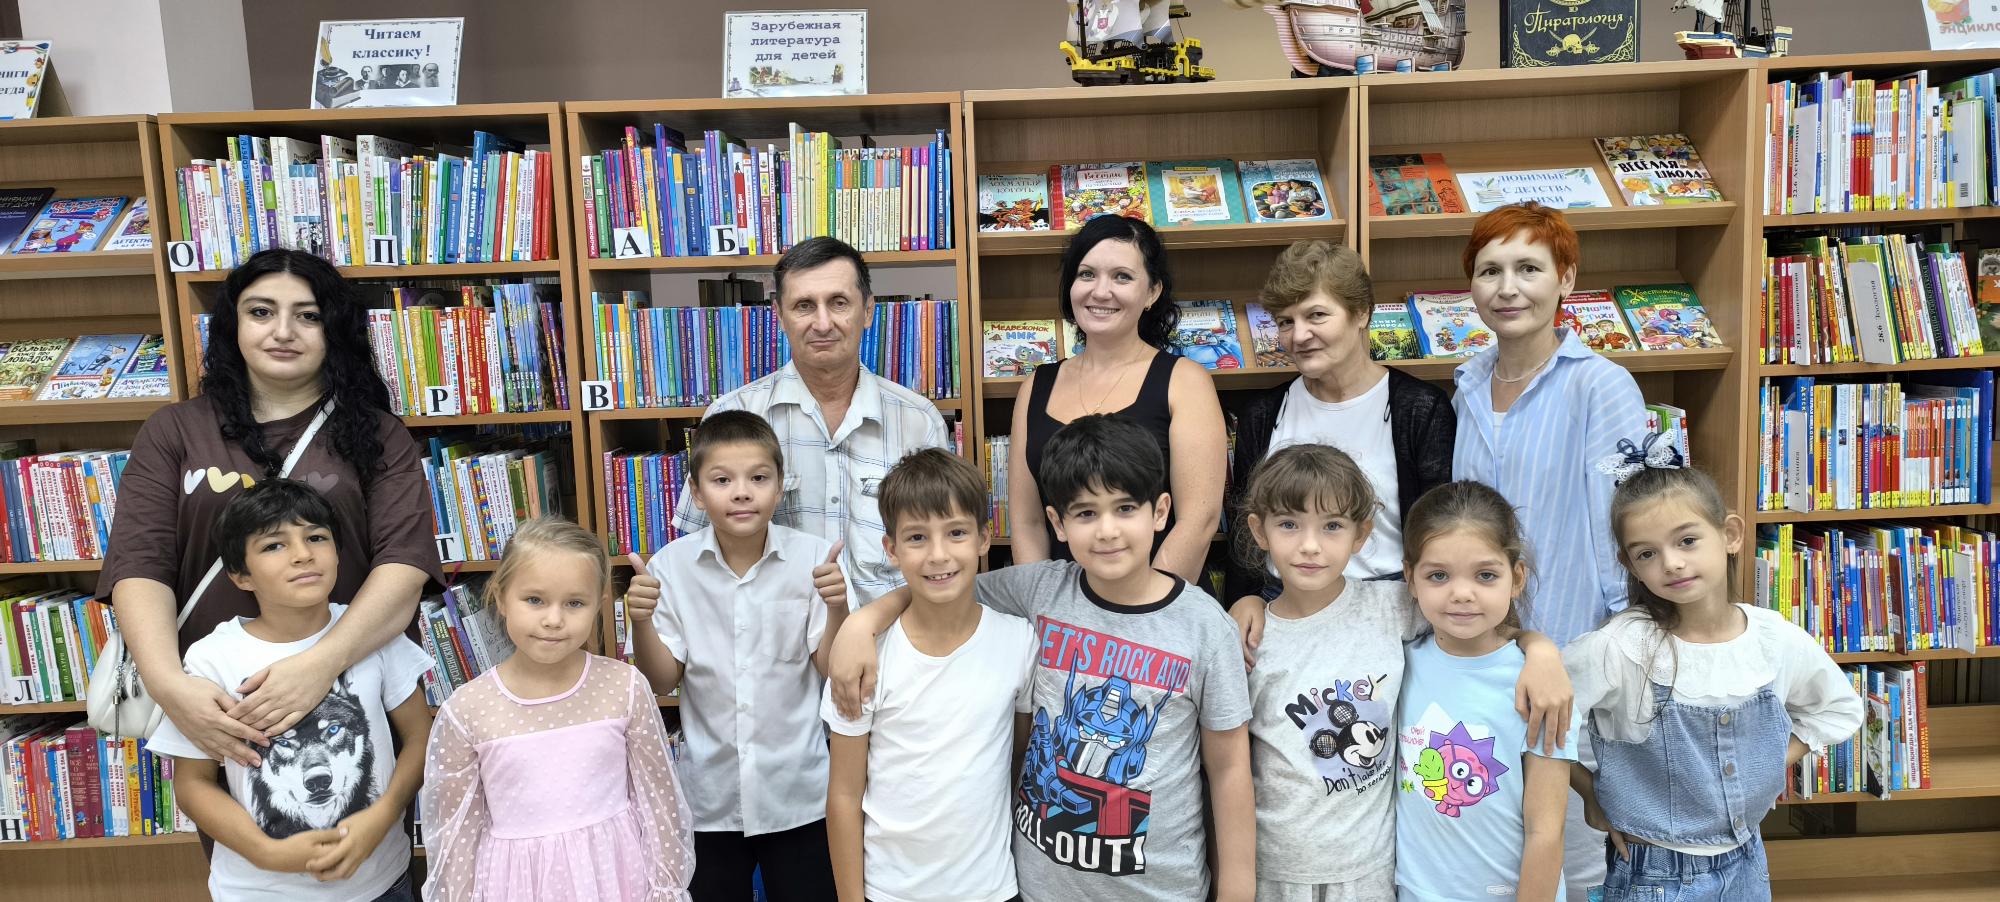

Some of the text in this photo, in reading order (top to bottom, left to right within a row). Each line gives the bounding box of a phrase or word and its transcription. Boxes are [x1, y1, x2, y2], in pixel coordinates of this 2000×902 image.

[751, 21, 841, 32] Зарубежная
[1524, 2, 1623, 34] Пиратология
[364, 28, 421, 40] Читаем
[750, 36, 840, 46] литература
[352, 48, 422, 60] классику
[756, 50, 836, 62] для детей
[1654, 169, 1704, 180] ШКОЛА
[1514, 184, 1572, 194] ДЕТСТВА
[468, 191, 478, 238] БУМАЖНЫЙ
[738, 194, 746, 214] Барри
[373, 237, 394, 264] П
[620, 231, 643, 256] А
[716, 228, 736, 252] Б
[170, 242, 194, 268] О
[990, 324, 1050, 333] МЕДВЕЖОНОК
[1006, 332, 1036, 340] МИК
[430, 388, 448, 412] Р
[588, 385, 609, 409] В
[1099, 639, 1156, 682] ROCK
[1155, 656, 1192, 689] AND
[14, 680, 33, 702] Л
[0, 818, 21, 840] Н
[1014, 801, 1146, 874] ROLL-OUT!
